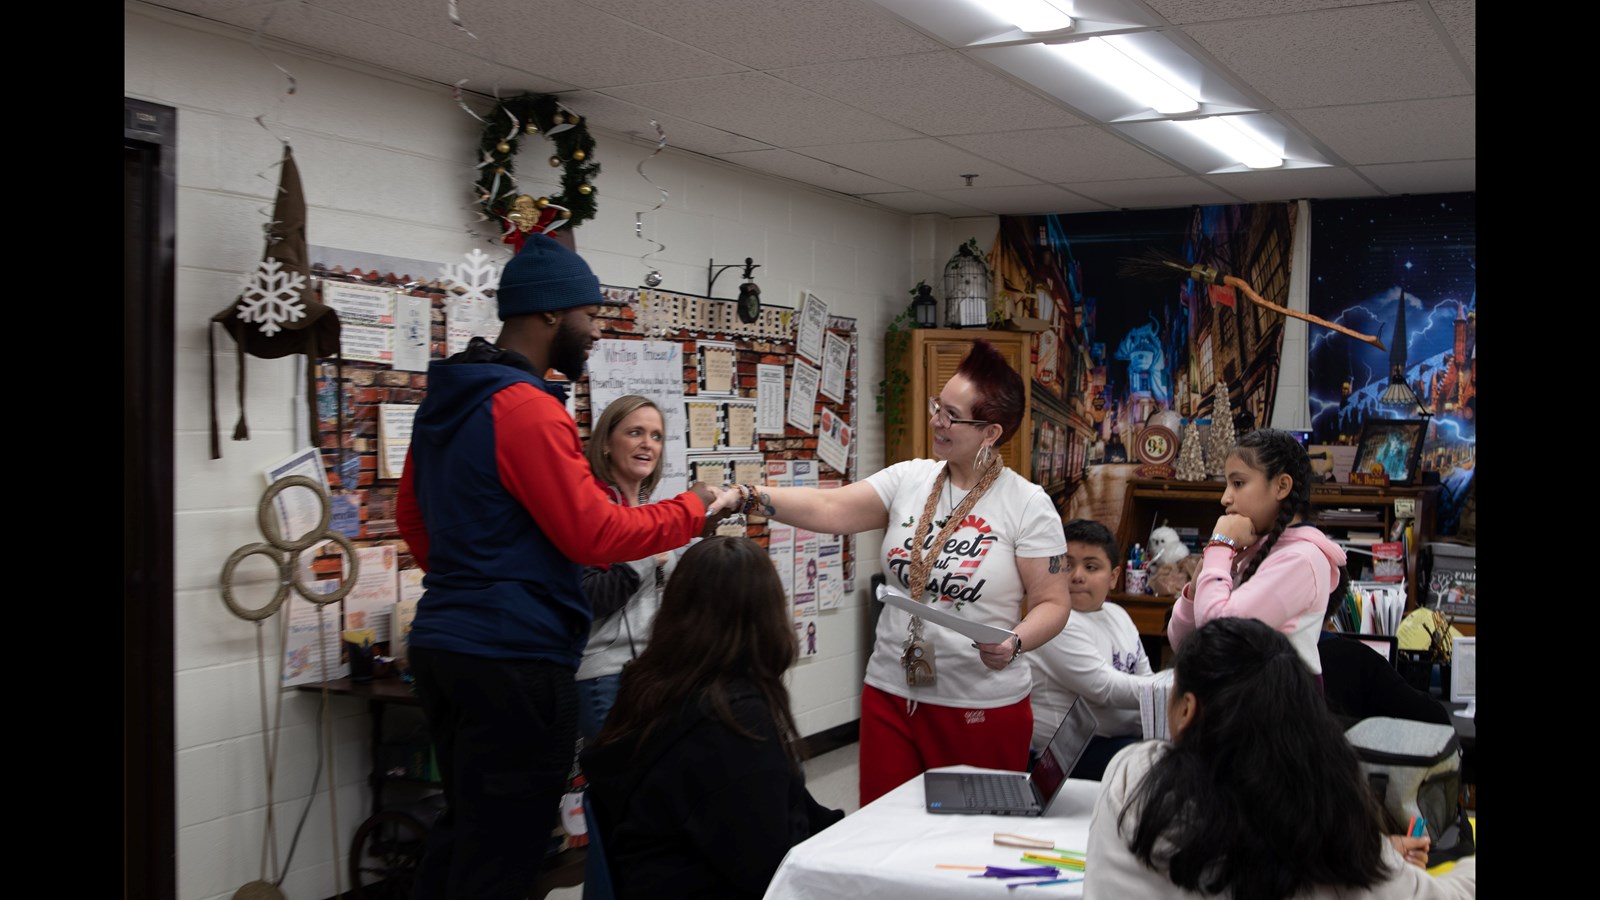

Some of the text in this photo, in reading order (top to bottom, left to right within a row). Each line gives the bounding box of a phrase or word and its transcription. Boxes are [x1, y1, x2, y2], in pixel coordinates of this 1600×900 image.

[603, 343, 638, 365] Writing
[1147, 438, 1157, 453] 9
[889, 558, 986, 603] Tsted
